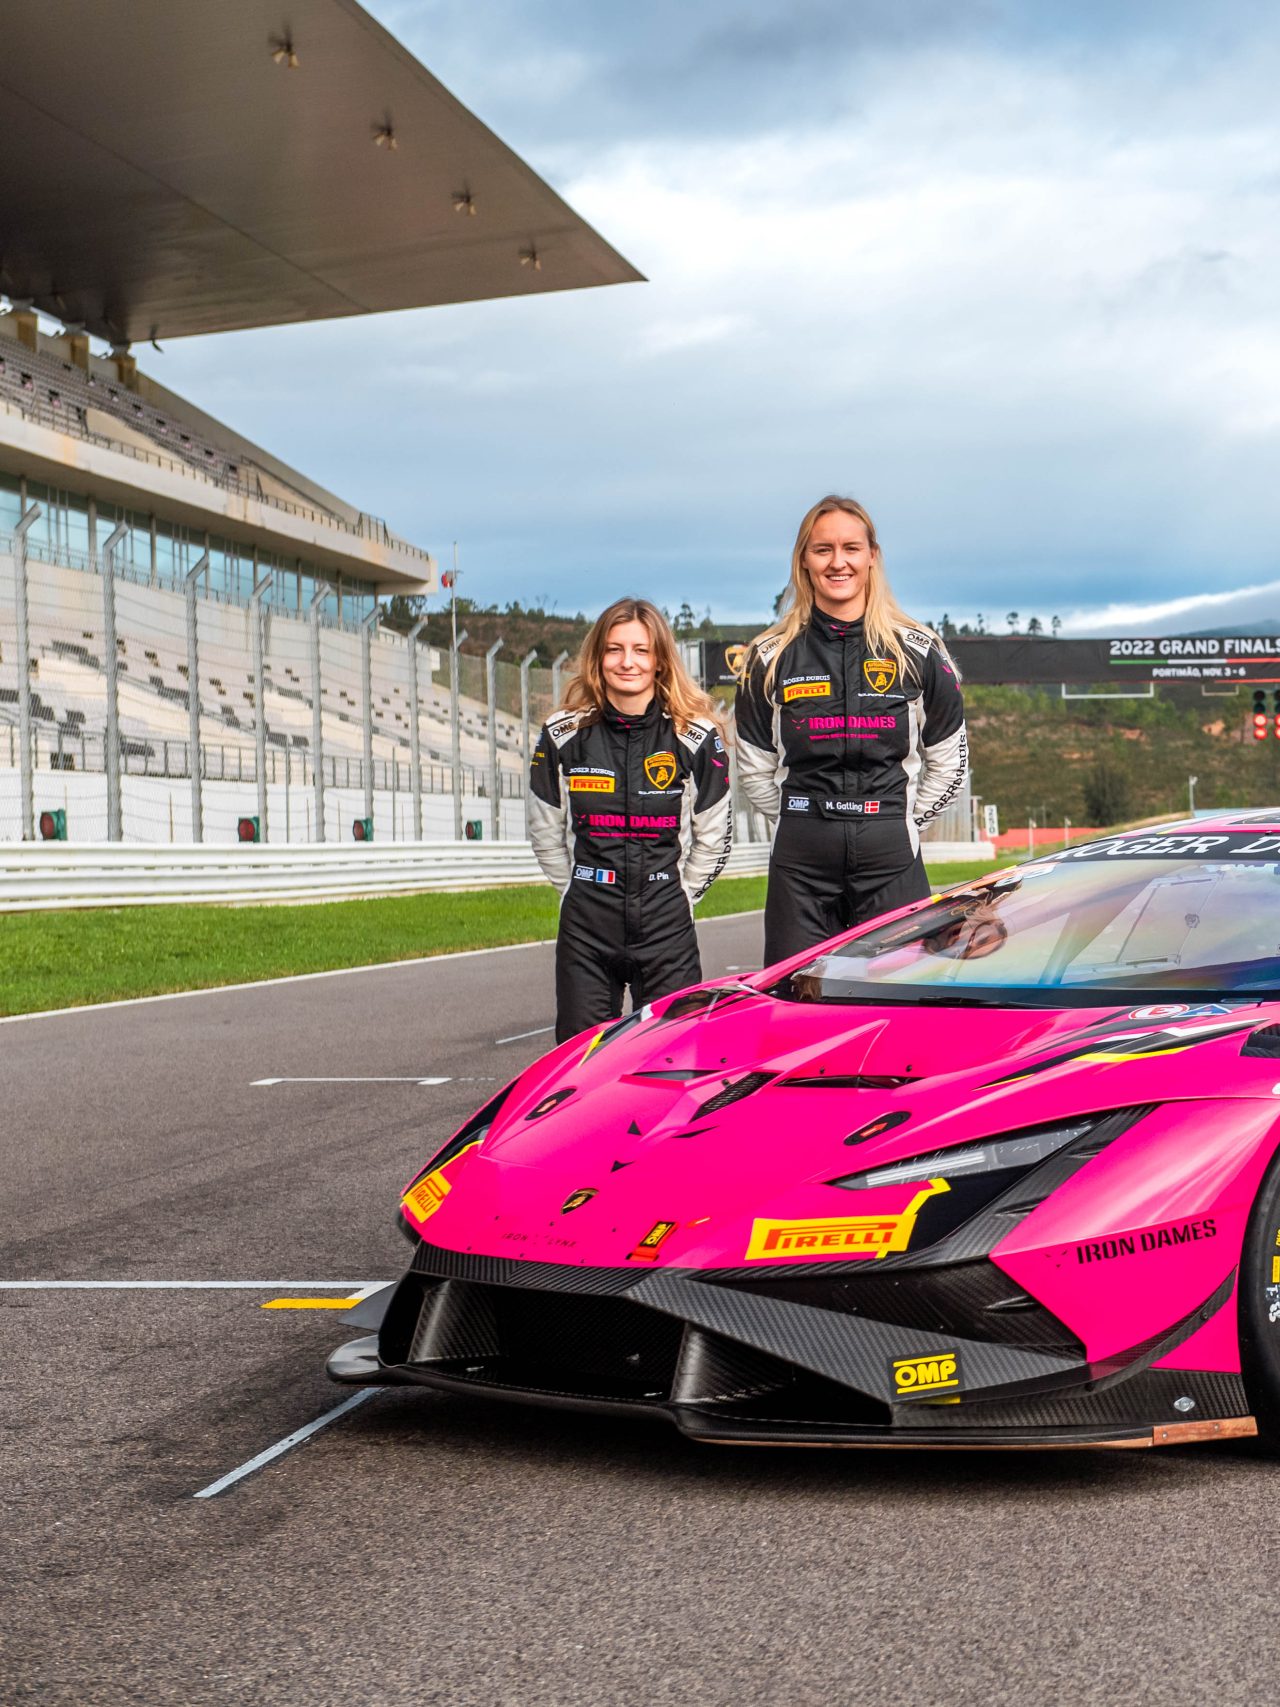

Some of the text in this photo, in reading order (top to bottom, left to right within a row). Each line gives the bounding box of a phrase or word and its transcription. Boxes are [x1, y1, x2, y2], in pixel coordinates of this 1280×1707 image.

[1109, 640, 1155, 655] 2022
[1159, 639, 1220, 655] GRAND
[783, 674, 831, 685] ROGER DUBUIS
[808, 714, 897, 730] IRON DAMES
[788, 798, 810, 810] OMP
[825, 801, 835, 810] M.
[589, 814, 677, 829] IRON DAMES
[656, 871, 670, 881] Pin
[409, 1177, 446, 1214] PIRELLI
[762, 1221, 898, 1251] PIRELLI
[1077, 1218, 1218, 1265] IRON DAMES
[894, 1358, 957, 1387] OMP
